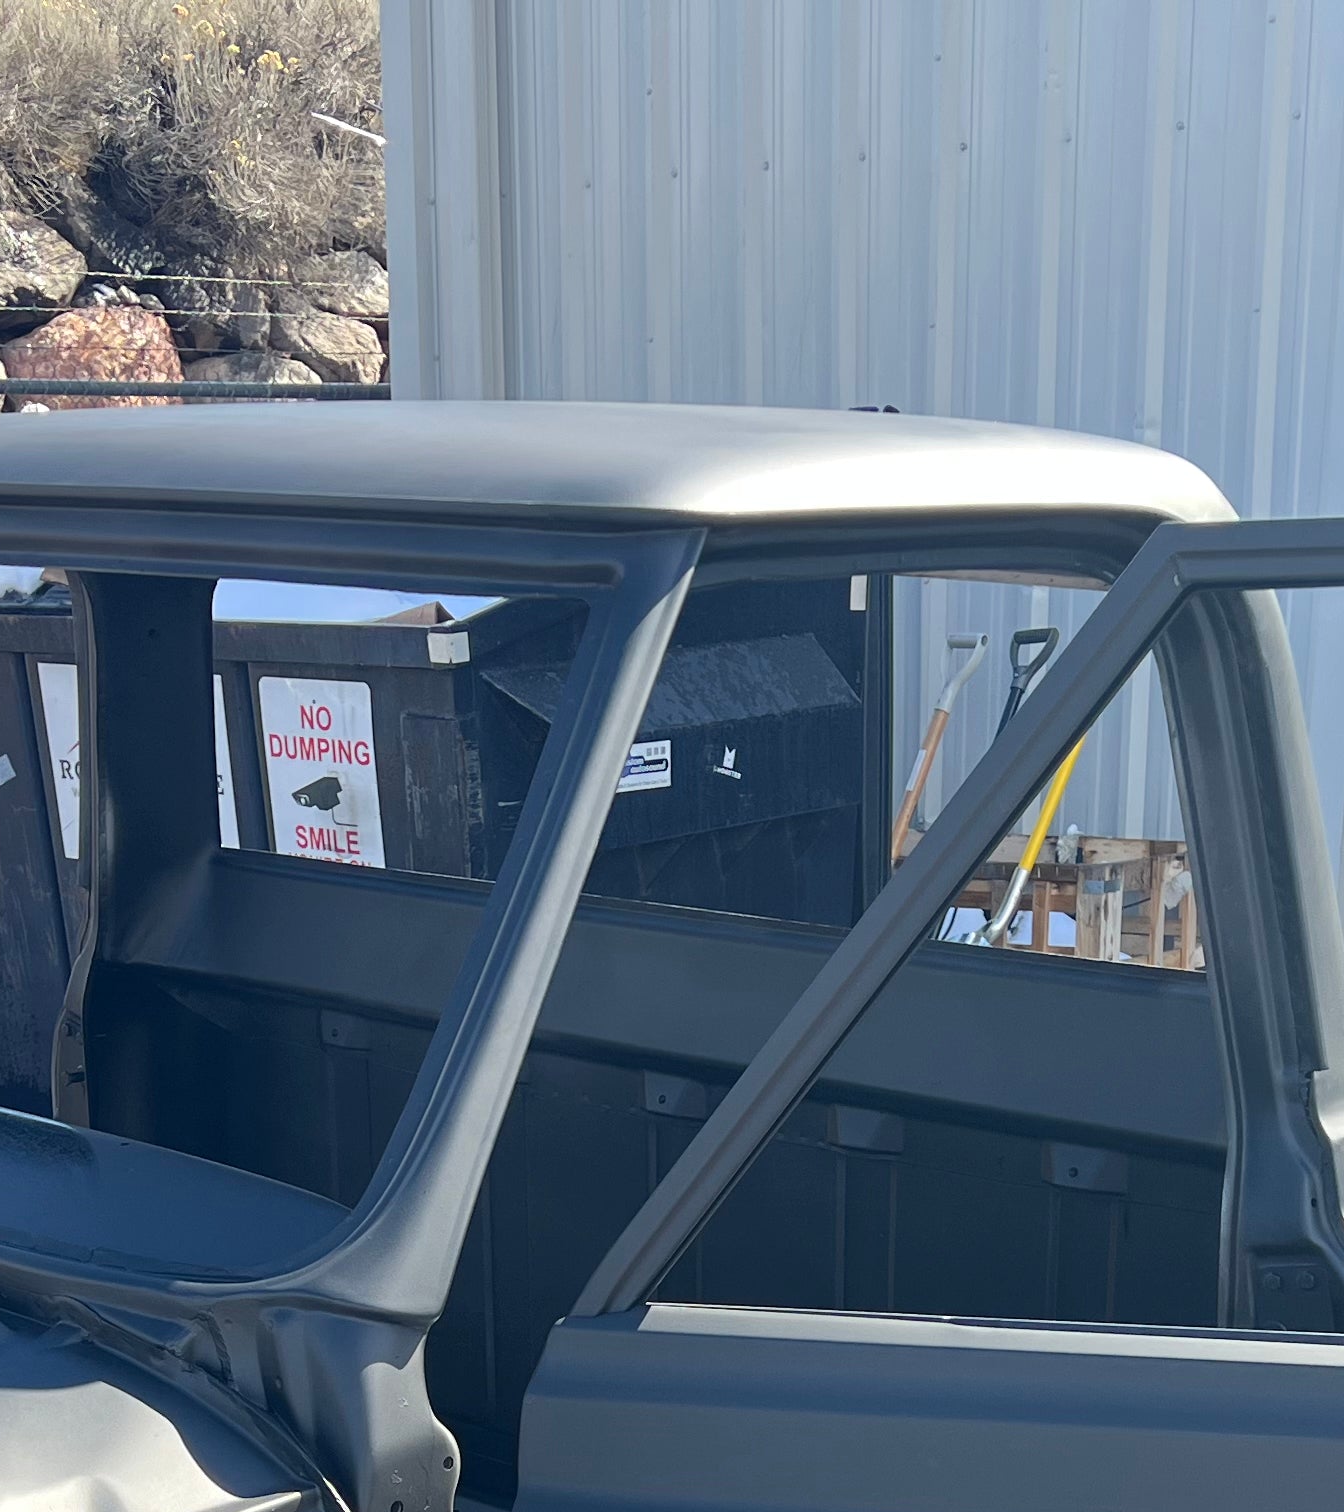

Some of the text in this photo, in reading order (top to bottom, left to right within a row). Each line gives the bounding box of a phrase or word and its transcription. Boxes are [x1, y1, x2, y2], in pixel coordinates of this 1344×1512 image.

[299, 704, 332, 731] NO
[268, 733, 371, 766] DUMPING
[295, 825, 361, 855] SMILE
